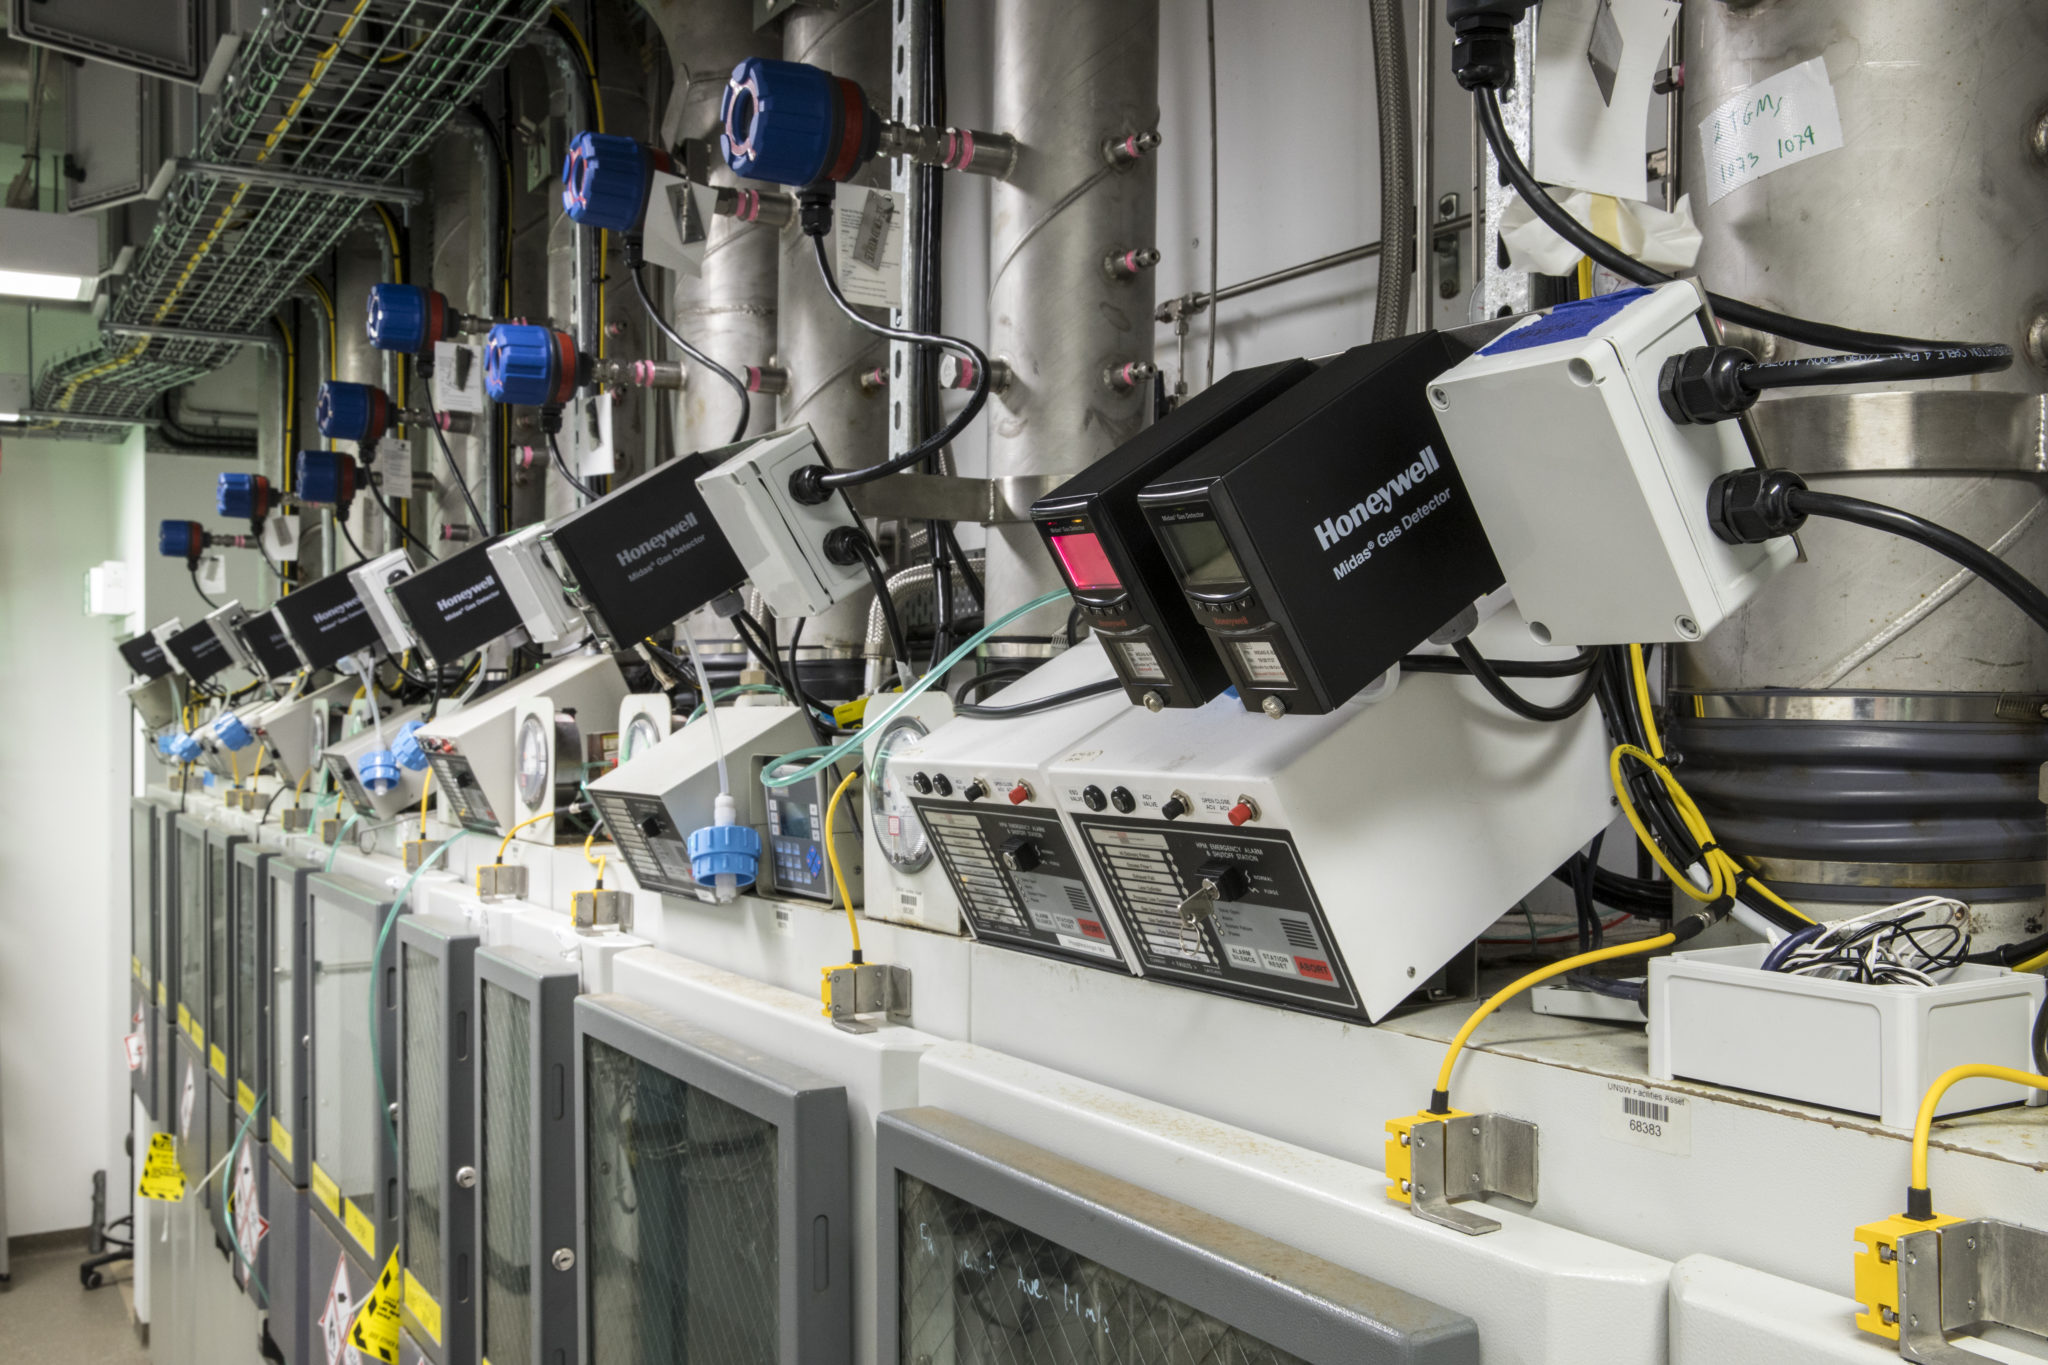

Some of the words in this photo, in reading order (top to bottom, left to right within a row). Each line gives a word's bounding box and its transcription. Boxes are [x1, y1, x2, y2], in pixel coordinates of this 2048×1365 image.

[1721, 152, 1759, 183] 1073
[1778, 125, 1814, 158] 1074
[1314, 445, 1440, 551] Honeywell
[1377, 525, 1402, 548] Gas
[1401, 488, 1450, 530] Detector
[616, 512, 699, 567] Honeywell
[656, 552, 673, 567] Gas
[672, 533, 706, 556] Detector
[436, 574, 496, 612] Honeywell
[464, 602, 476, 612] Gas
[475, 590, 500, 606] Detector
[313, 596, 360, 624] Honeywe
[1210, 843, 1241, 852] EMERGENCY
[1236, 853, 1259, 861] STATION
[1232, 948, 1251, 956] ALARM
[1232, 954, 1256, 963] SILENCE
[1262, 953, 1289, 963] STATION
[1268, 960, 1288, 969] RESET
[1300, 962, 1329, 975] ABORT
[1608, 1083, 1631, 1094] UNSW
[1633, 1088, 1662, 1101] Facilities
[1664, 1096, 1685, 1106] Asset
[1629, 1119, 1662, 1137] 68383
